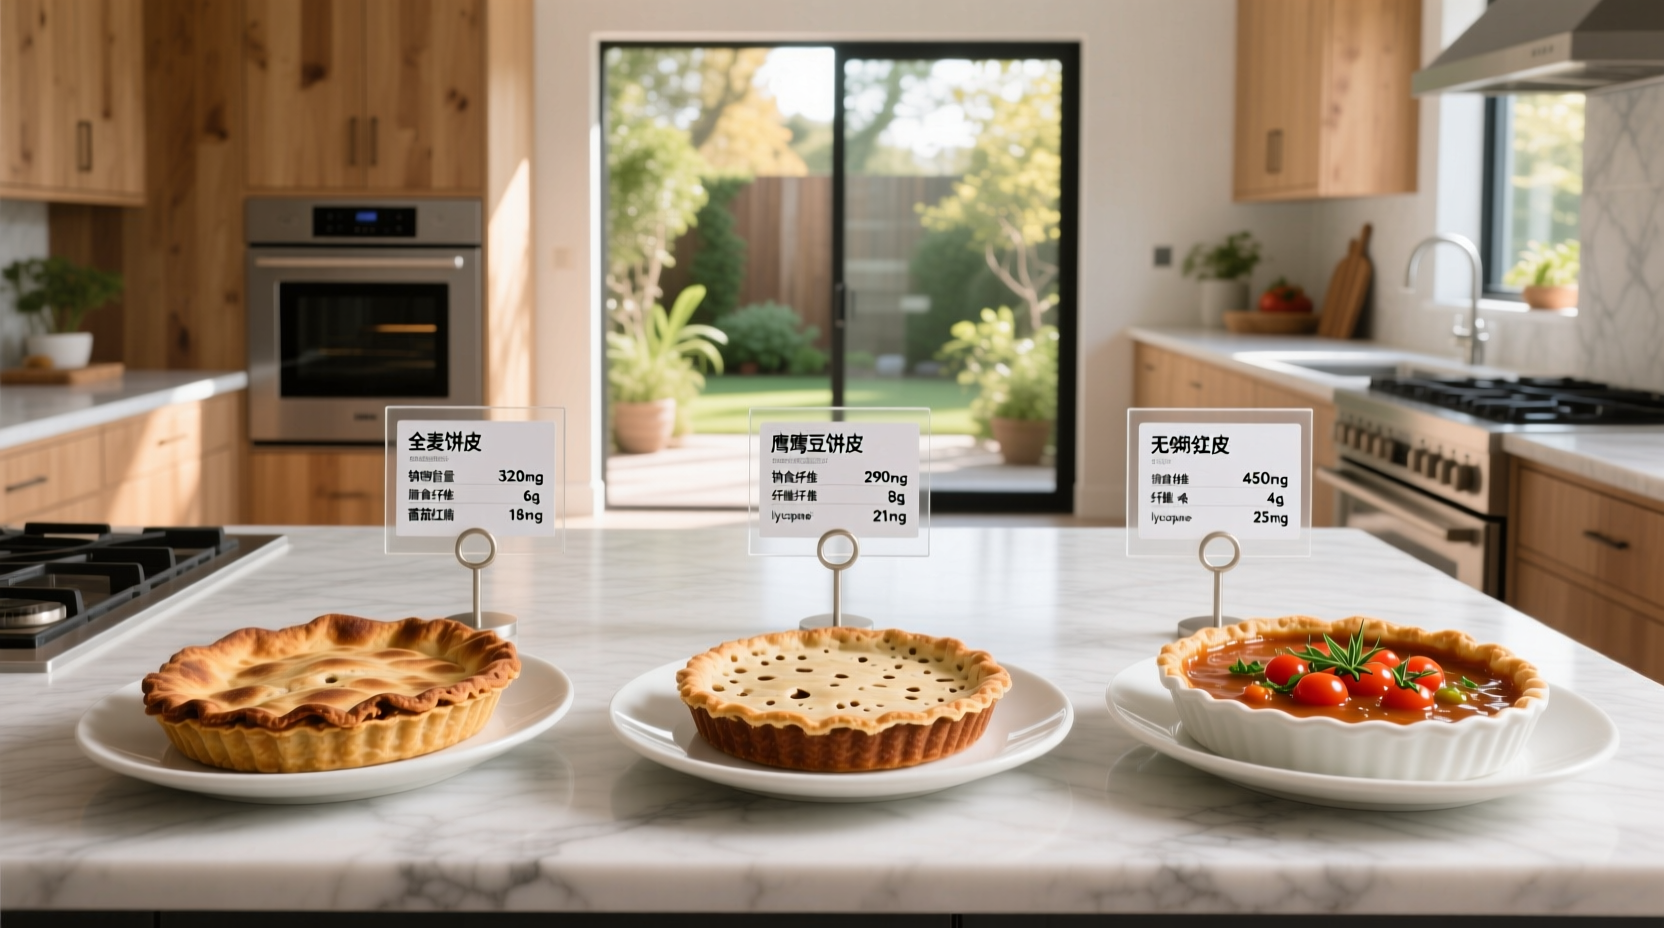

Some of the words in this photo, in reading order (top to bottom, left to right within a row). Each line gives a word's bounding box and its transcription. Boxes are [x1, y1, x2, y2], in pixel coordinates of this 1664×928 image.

[408, 431, 482, 452] 全麦饼皮
[498, 470, 544, 485] 320mg
[523, 490, 540, 505] 6g
[888, 490, 905, 505] 8g
[1267, 492, 1284, 507] 4g
[1253, 510, 1288, 527] 25mg
